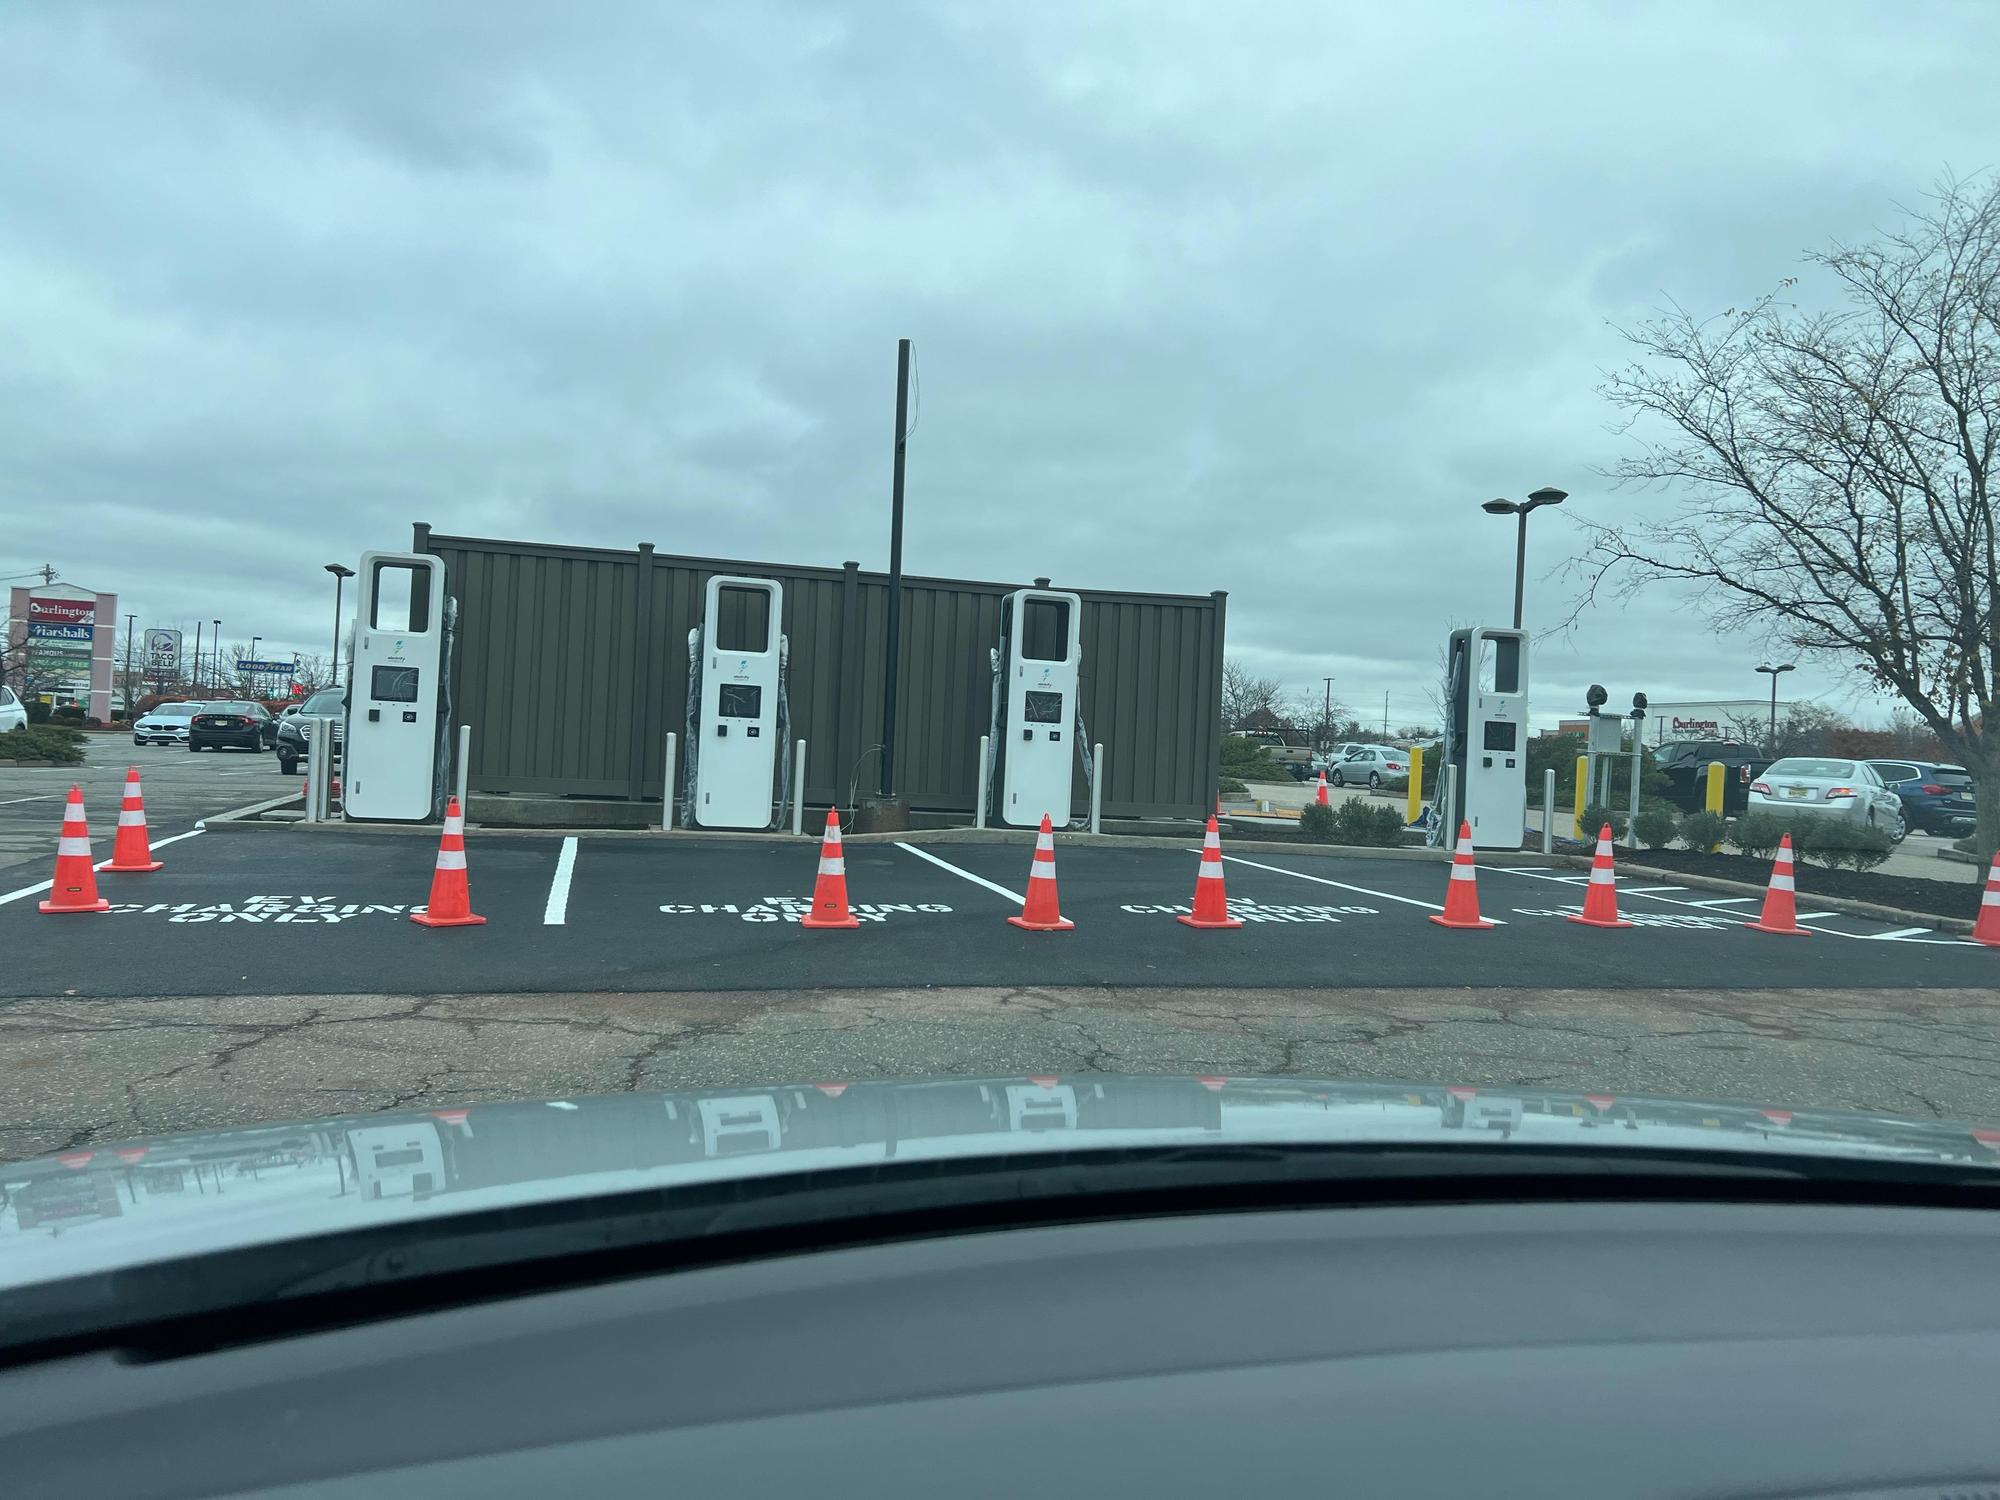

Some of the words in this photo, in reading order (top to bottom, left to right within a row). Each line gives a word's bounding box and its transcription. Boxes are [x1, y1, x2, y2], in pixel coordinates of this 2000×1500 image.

[150, 652, 174, 660] TACO
[1672, 716, 1718, 731] Burlington
[241, 895, 336, 904] EV
[168, 912, 359, 923] ONLY
